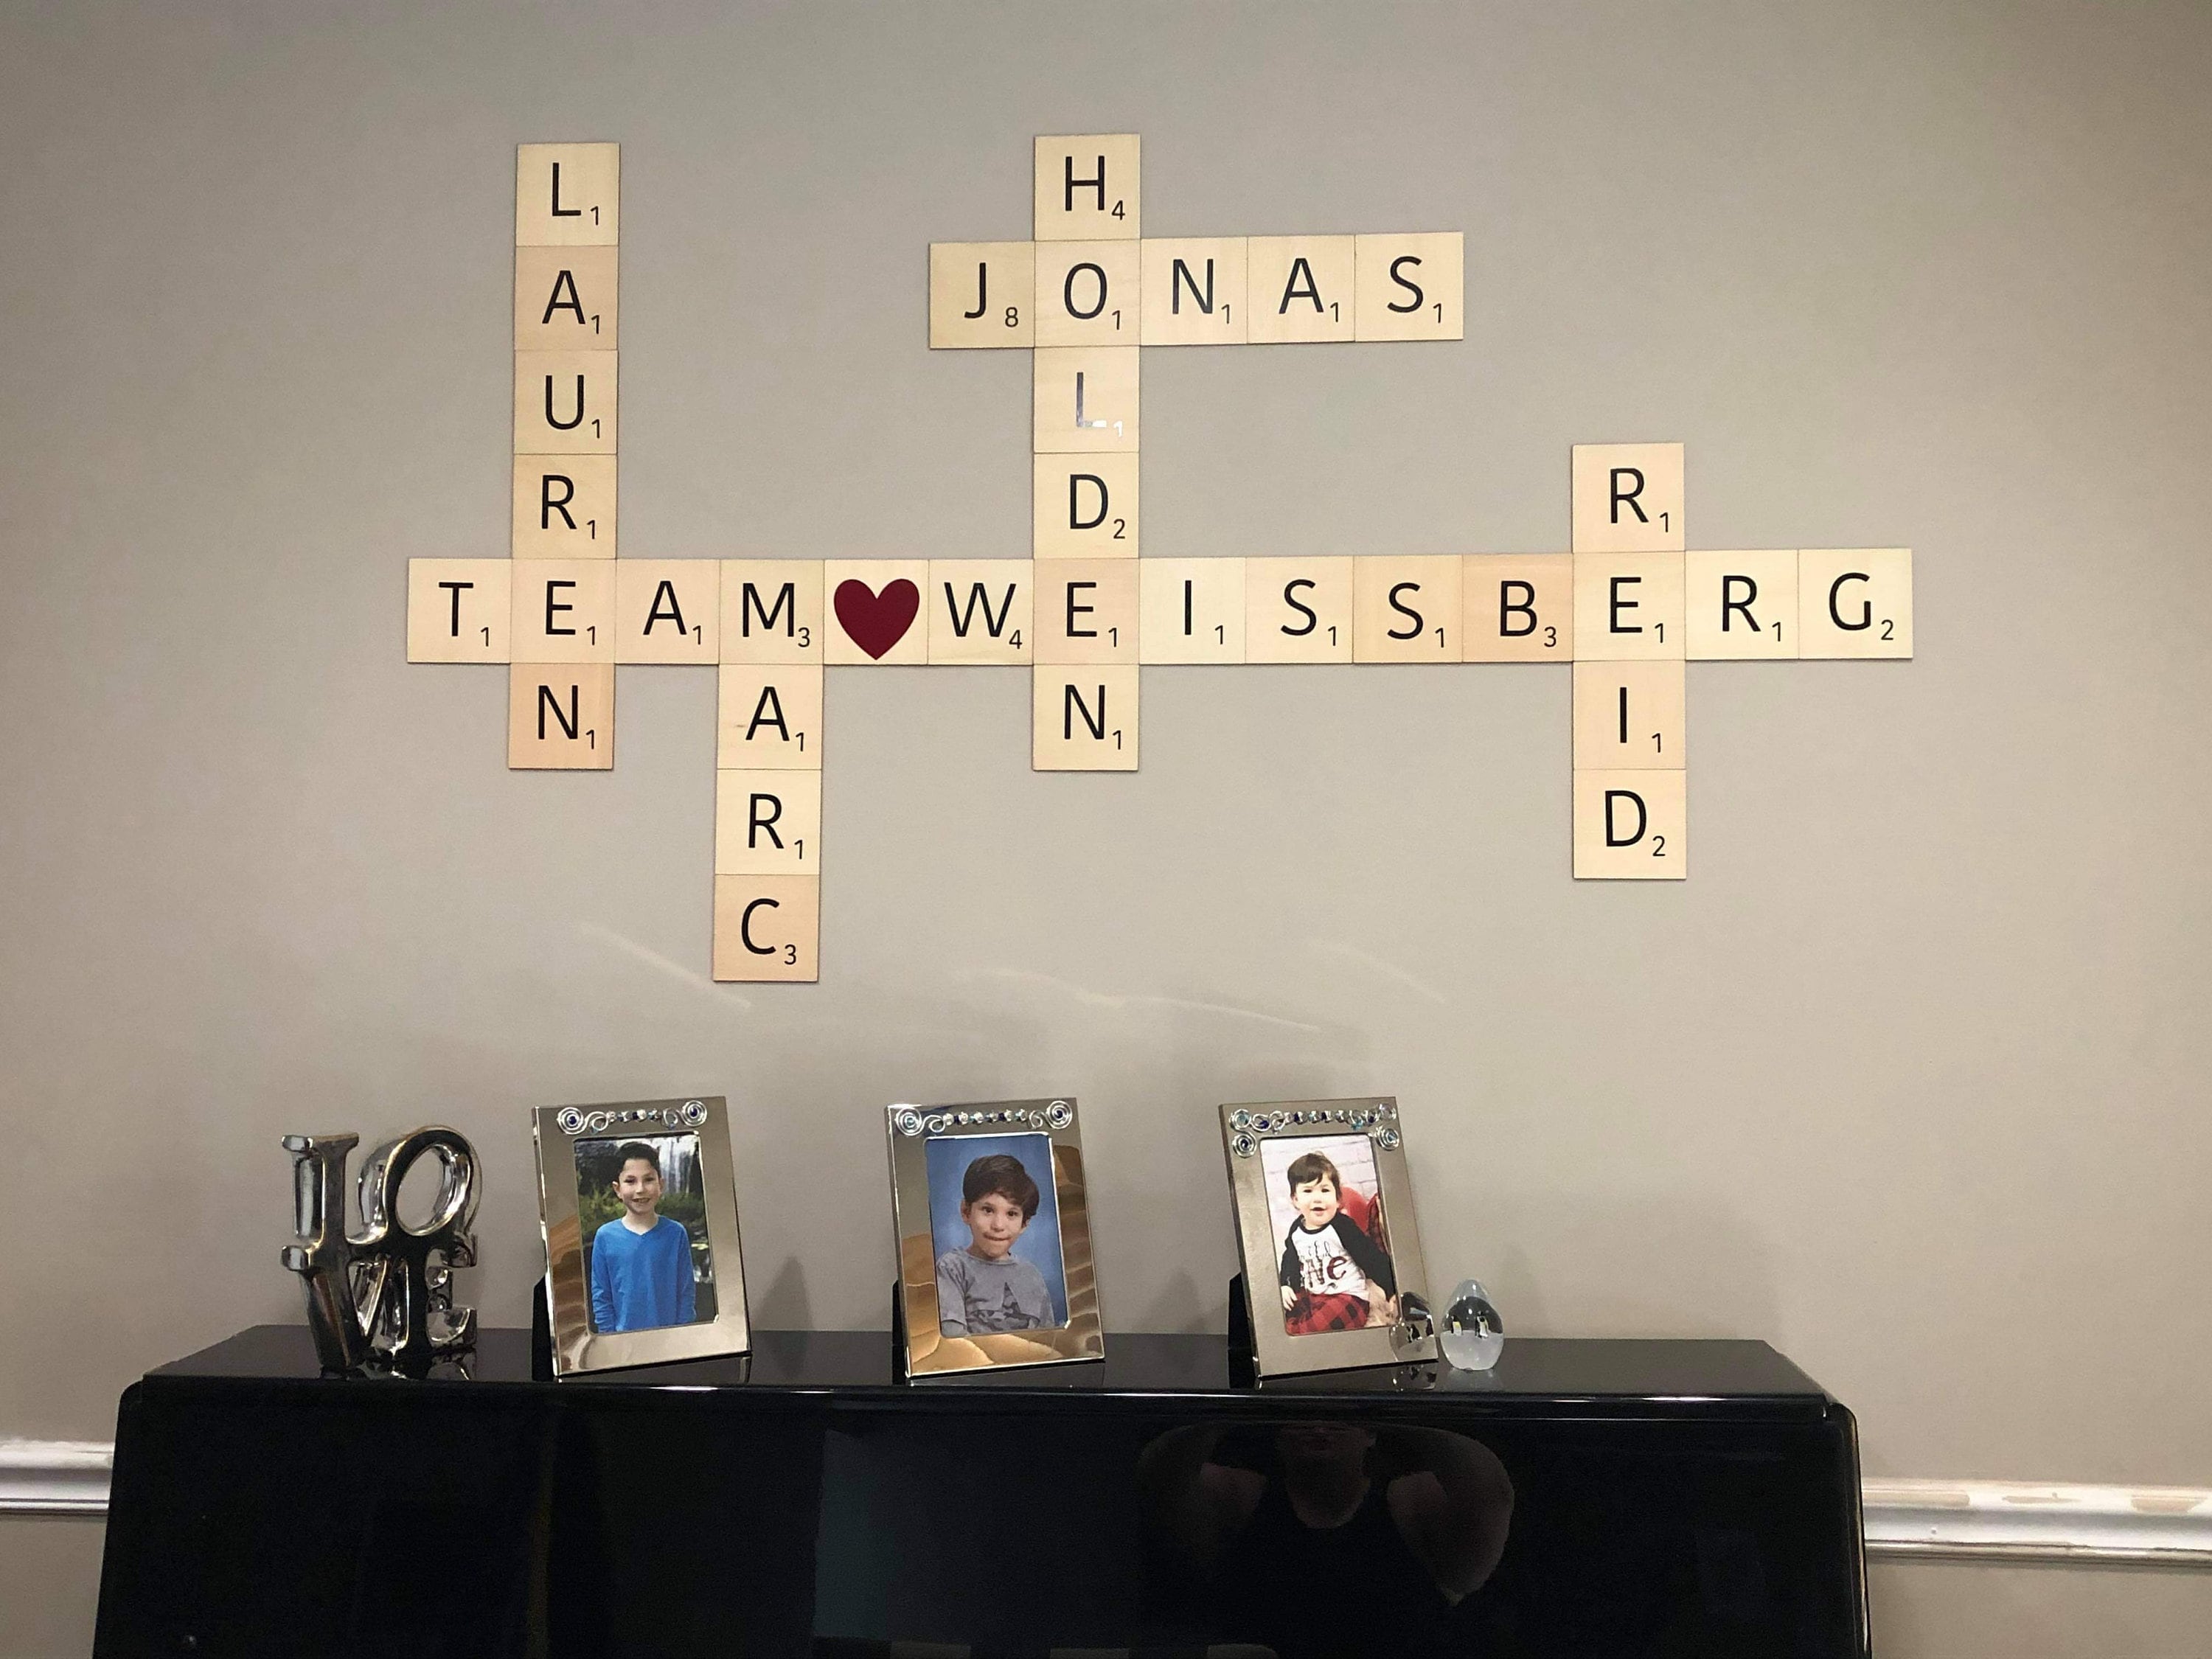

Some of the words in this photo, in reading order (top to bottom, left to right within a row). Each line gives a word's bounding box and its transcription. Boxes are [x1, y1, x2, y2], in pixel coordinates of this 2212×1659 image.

[590, 206, 599, 226] 1
[1111, 200, 1126, 220] 4
[964, 257, 1423, 319] JONAS
[1004, 307, 1019, 328] 8
[1112, 310, 1121, 330] 1
[1221, 304, 1230, 324] 1
[1330, 302, 1338, 323] 1
[1433, 303, 1441, 324] 1
[591, 314, 600, 335] 1
[591, 418, 600, 439] 1
[1113, 420, 1124, 438] 1
[538, 163, 585, 740] LAUREN
[1065, 156, 1107, 740] HOLDEN
[586, 519, 596, 540] 1
[1113, 518, 1125, 539] 2
[1660, 512, 1669, 533] 1
[439, 581, 794, 637] TEAM
[945, 573, 1871, 639] WEISSBERG
[481, 627, 489, 647] 1
[586, 625, 596, 646] 1
[692, 625, 701, 645] 1
[798, 627, 810, 648] 3
[1009, 629, 1023, 650] 4
[1108, 627, 1117, 647] 1
[1214, 625, 1223, 645] 1
[1327, 626, 1336, 647] 1
[1435, 627, 1444, 648] 1
[1544, 626, 1557, 647] 3
[1655, 622, 1663, 644] 1
[1772, 622, 1781, 642] 1
[1881, 619, 1893, 641] 2
[1605, 468, 1648, 846] REID
[585, 729, 595, 750] 1
[795, 732, 804, 752] 1
[1112, 730, 1121, 750] 1
[1652, 733, 1661, 754] 1
[742, 583, 794, 954] MARC
[794, 839, 803, 860] 1
[1652, 835, 1666, 857] 2
[784, 944, 796, 965] 3
